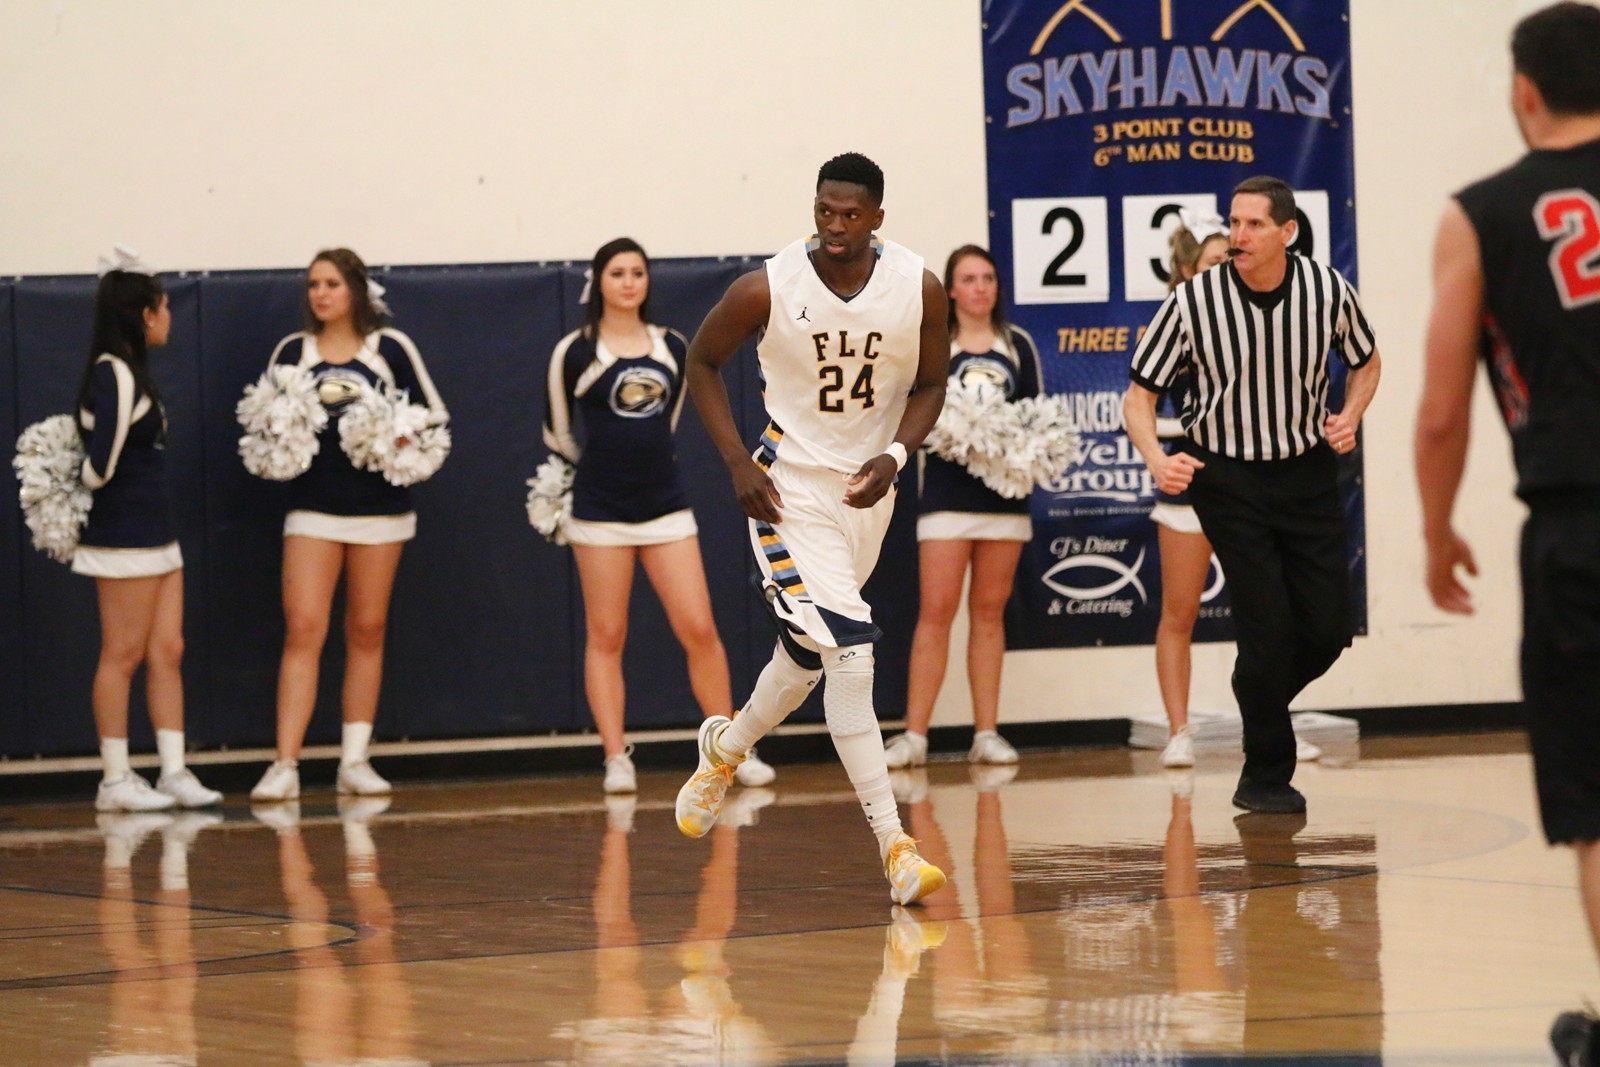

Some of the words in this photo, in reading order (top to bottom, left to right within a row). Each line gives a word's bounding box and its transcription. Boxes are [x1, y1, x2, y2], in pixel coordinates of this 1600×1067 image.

[1007, 46, 1331, 128] SKYHAWKS
[1093, 124, 1108, 143] 3
[1112, 117, 1183, 141] POINT
[1188, 117, 1254, 139] CLUB
[1126, 142, 1181, 163] MAN
[1189, 141, 1254, 163] CLUB
[1041, 207, 1087, 286] 2
[812, 330, 883, 362] FLC
[1057, 326, 1130, 353] THREE
[819, 364, 875, 413] 24
[1083, 535, 1130, 553] Diner
[1066, 595, 1134, 618] Catering
